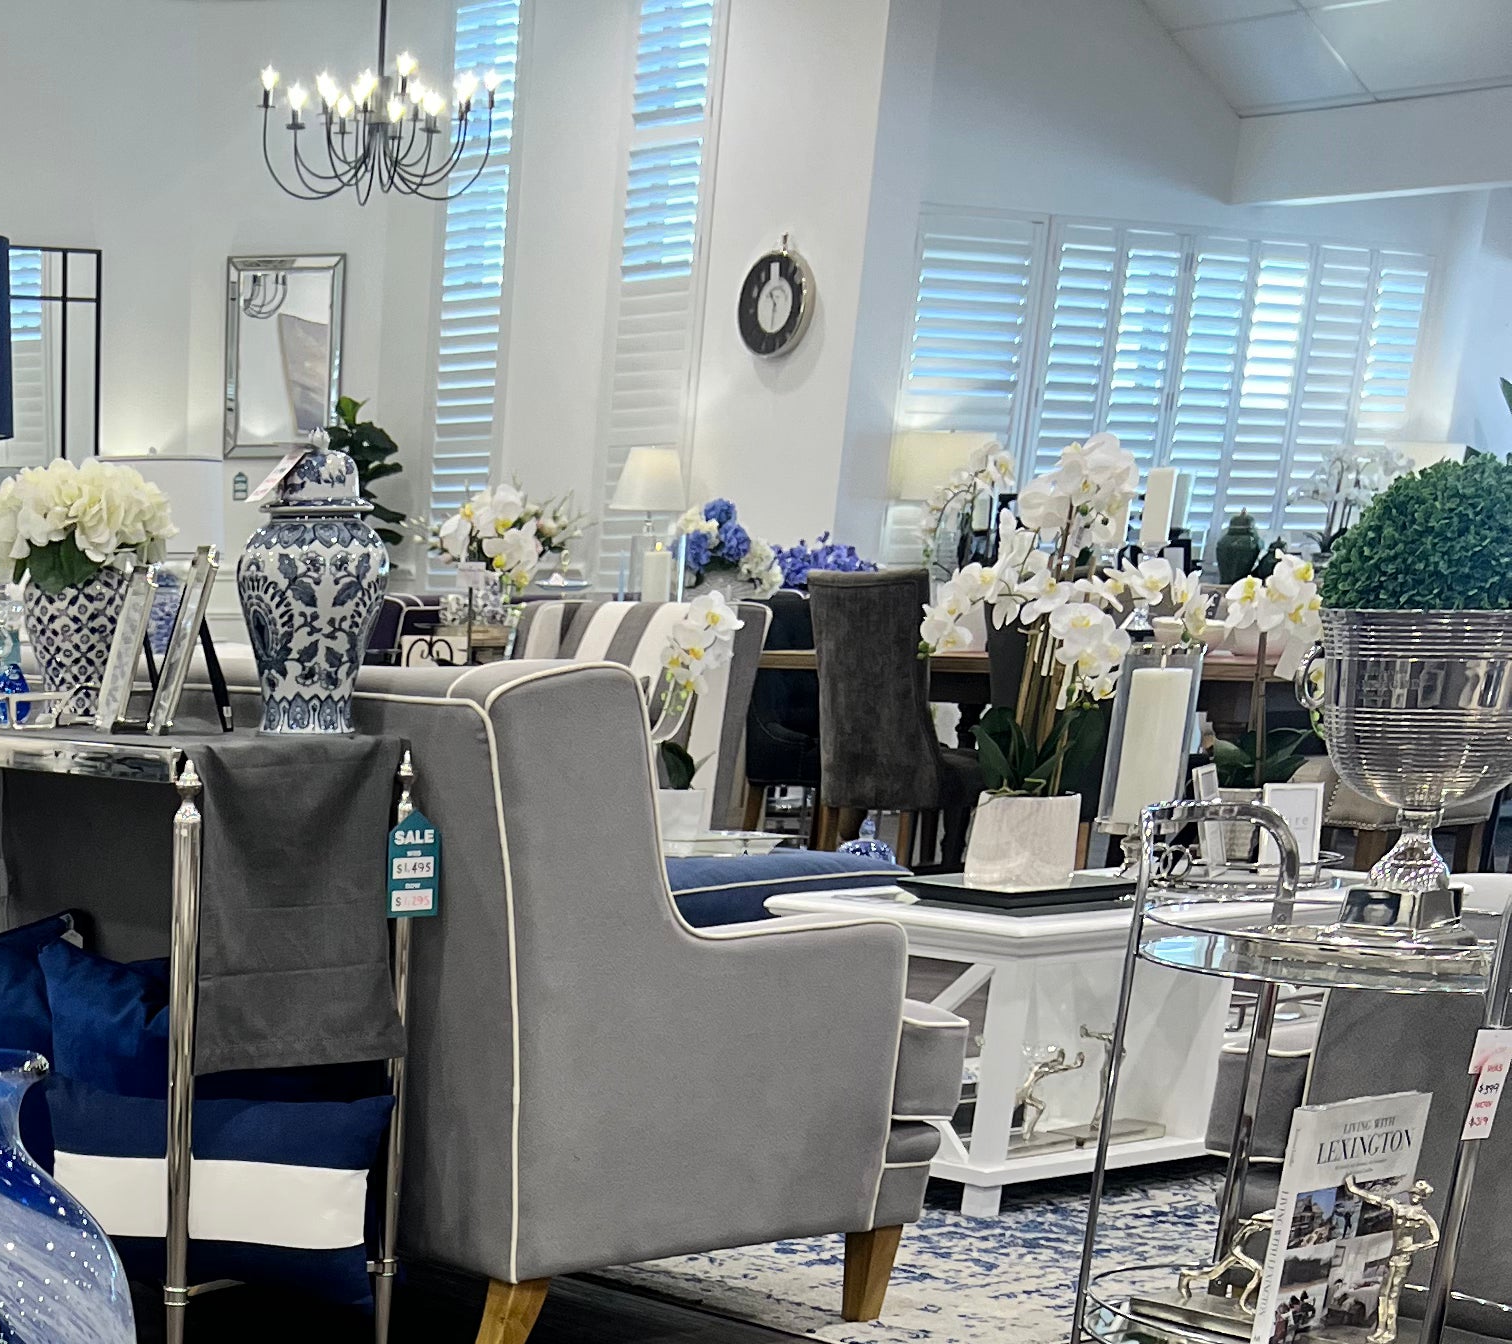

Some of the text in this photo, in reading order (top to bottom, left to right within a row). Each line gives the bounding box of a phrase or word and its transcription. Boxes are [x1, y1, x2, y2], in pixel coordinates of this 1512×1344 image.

[394, 829, 435, 845] SALE
[1343, 1116, 1396, 1135] LIVING WITH
[1316, 1128, 1415, 1165] LEXINGTON
